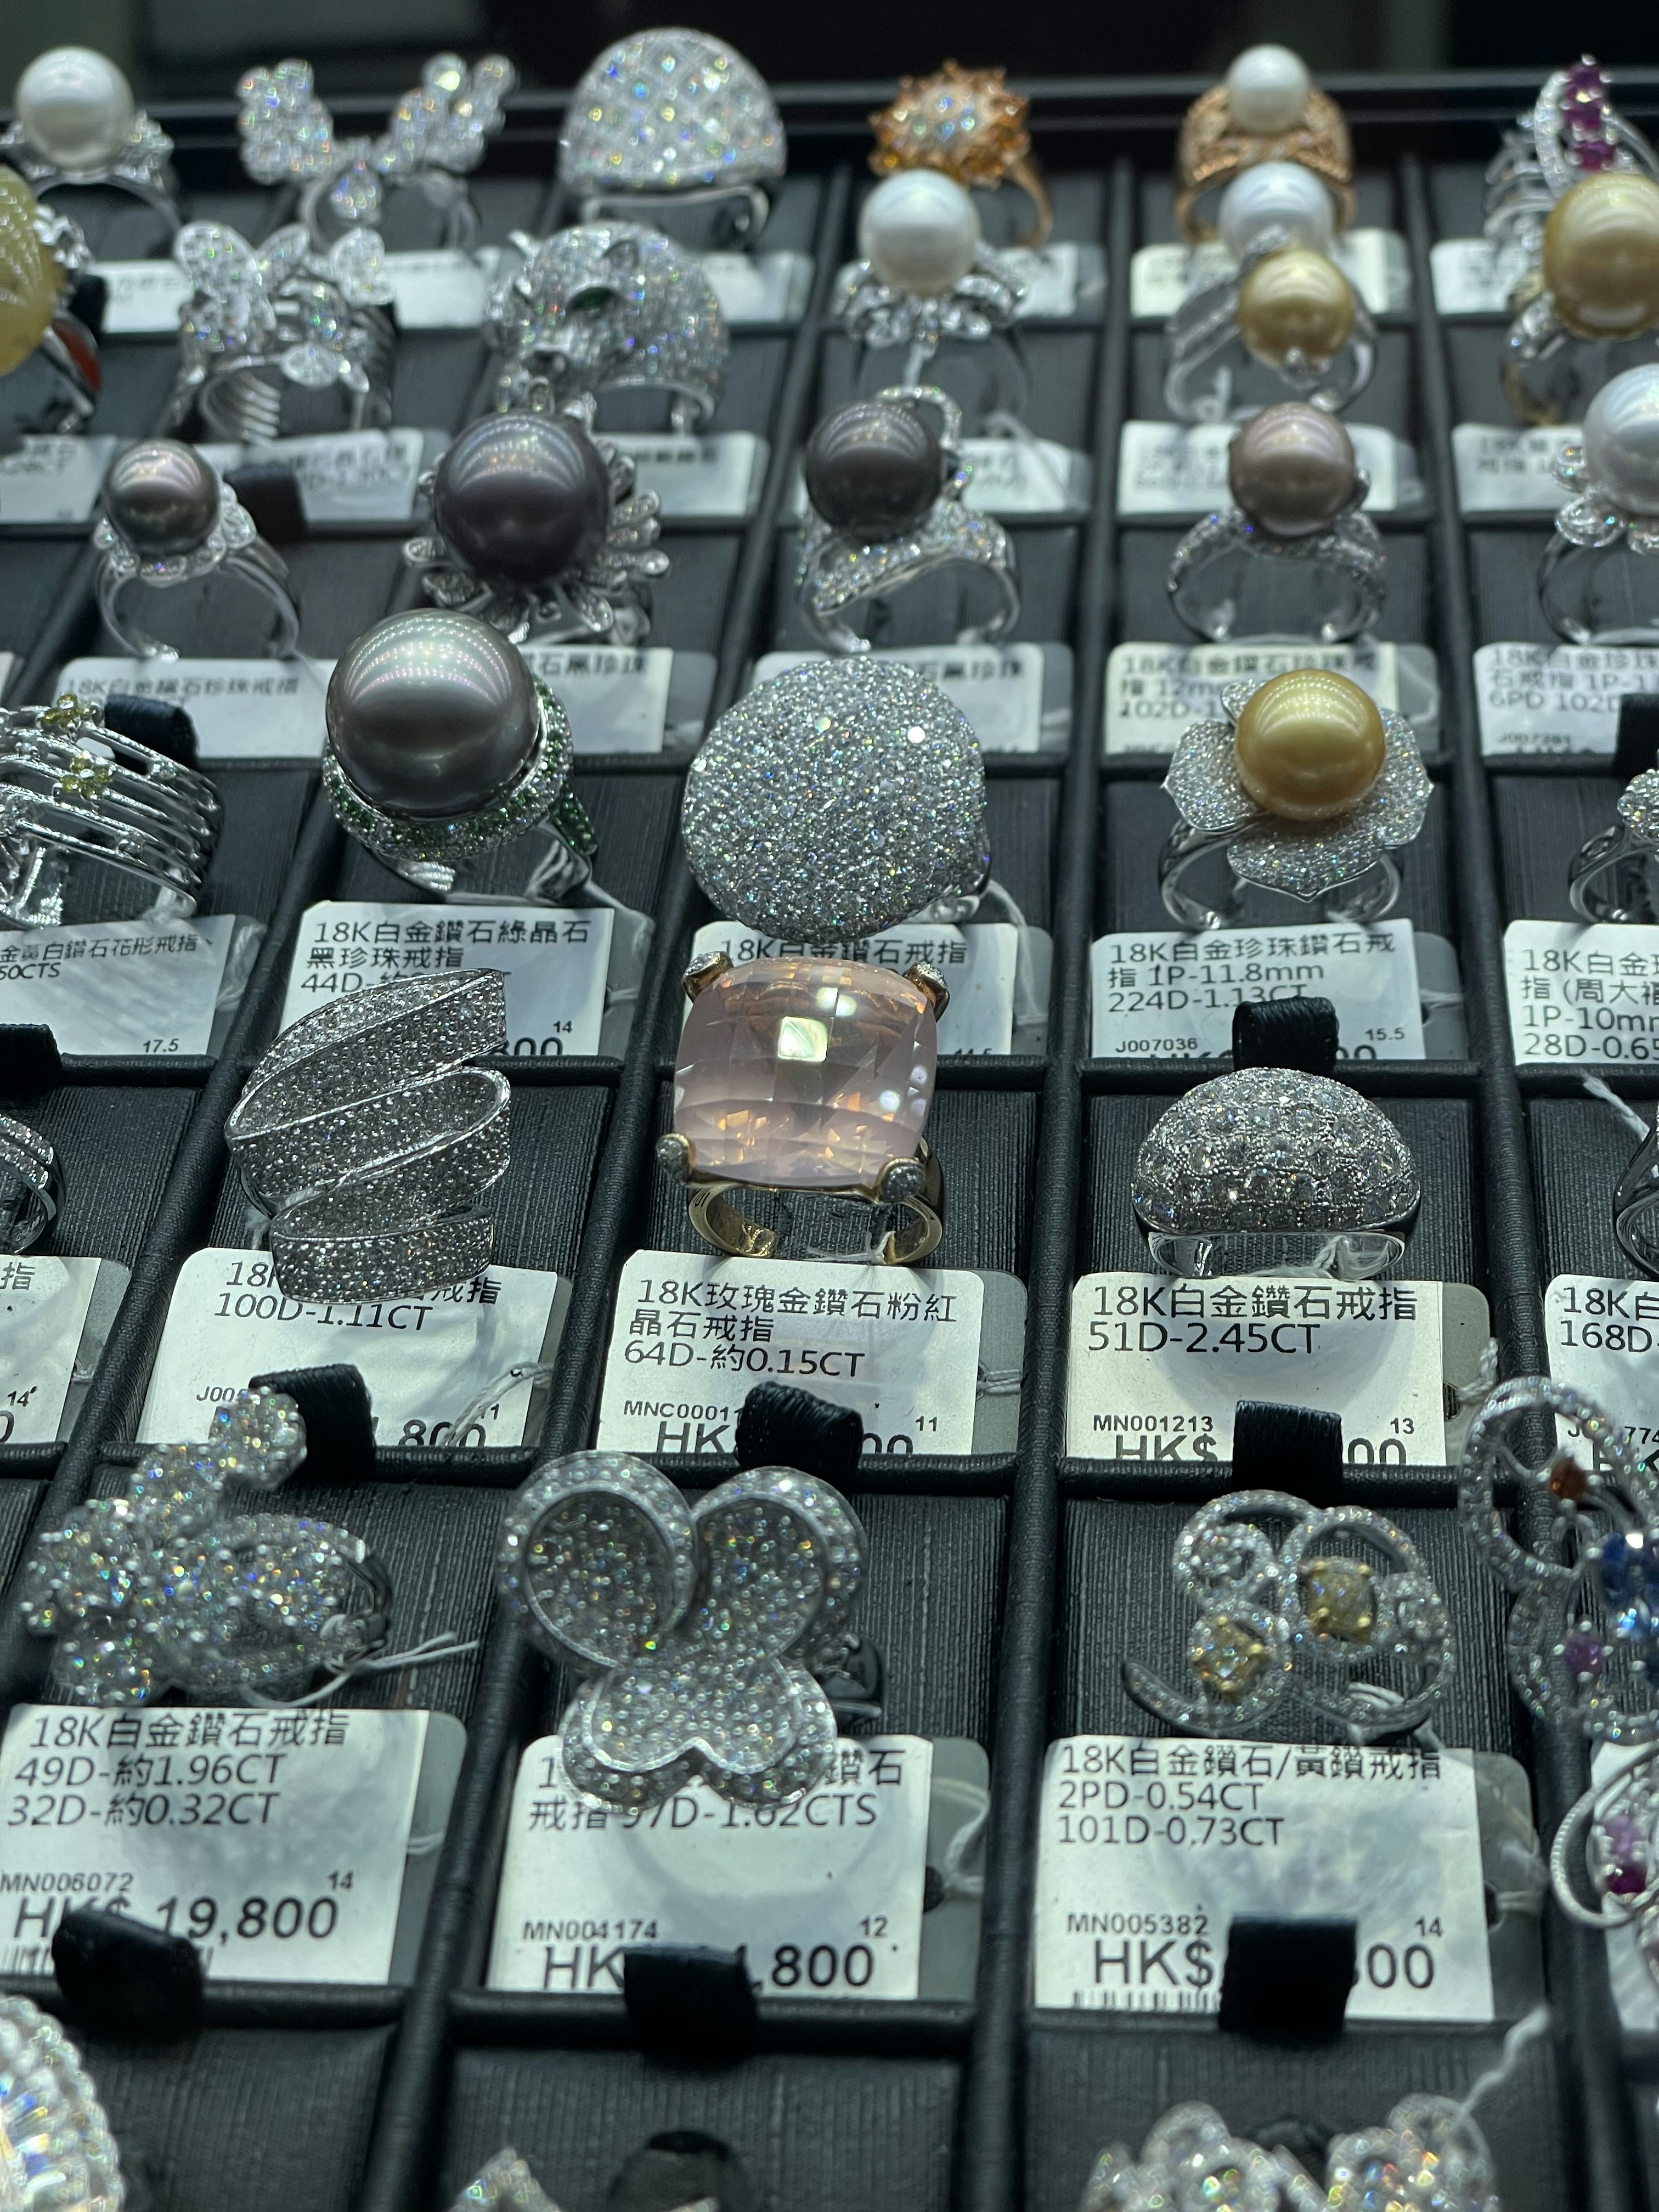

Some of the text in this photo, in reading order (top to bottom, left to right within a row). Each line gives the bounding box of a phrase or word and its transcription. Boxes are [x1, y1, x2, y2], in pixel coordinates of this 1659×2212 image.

[314, 920, 591, 944] 18K白金鑽石綠晶石
[307, 946, 464, 969] 黑珍珠戒指
[1111, 933, 1395, 964] 18K白金珍珠鑽石戒
[553, 1020, 573, 1034] 14
[1365, 1028, 1406, 1041] 15.5
[143, 1039, 179, 1053] 17.5
[1115, 1038, 1198, 1053] J007036
[214, 1292, 434, 1330] 100D-1.11CT
[637, 1279, 957, 1323] 18K玫瑰金鑽石粉紅
[1093, 1283, 1418, 1321] 18K白金鑽石戒指
[629, 1308, 774, 1342] 晶石戒指
[1088, 1321, 1320, 1354] 51D-2.45CT
[1560, 1319, 1659, 1353] 168D
[624, 1340, 865, 1378] 64D-約0.15CT
[915, 1415, 938, 1432] 11
[1093, 1414, 1415, 1435] MN001213 13
[30, 1708, 350, 1749] 18K白金鑽石戒指
[15, 1753, 287, 1787] 49D-約1.96CT
[1062, 1743, 1441, 1780] 18K白金鑽石/黃鑽戒指
[8, 1792, 281, 1826] 32D-約0.32CT
[1058, 1781, 1263, 1811] 2PD-0.54CT
[1057, 1816, 1285, 1846] 101D-0.73CT
[1, 1871, 354, 1892] MN006072 14
[523, 1916, 889, 1939] MN004174 12
[1068, 1913, 1443, 1938] MN005382 14
[1095, 1939, 1216, 1988] HK$
